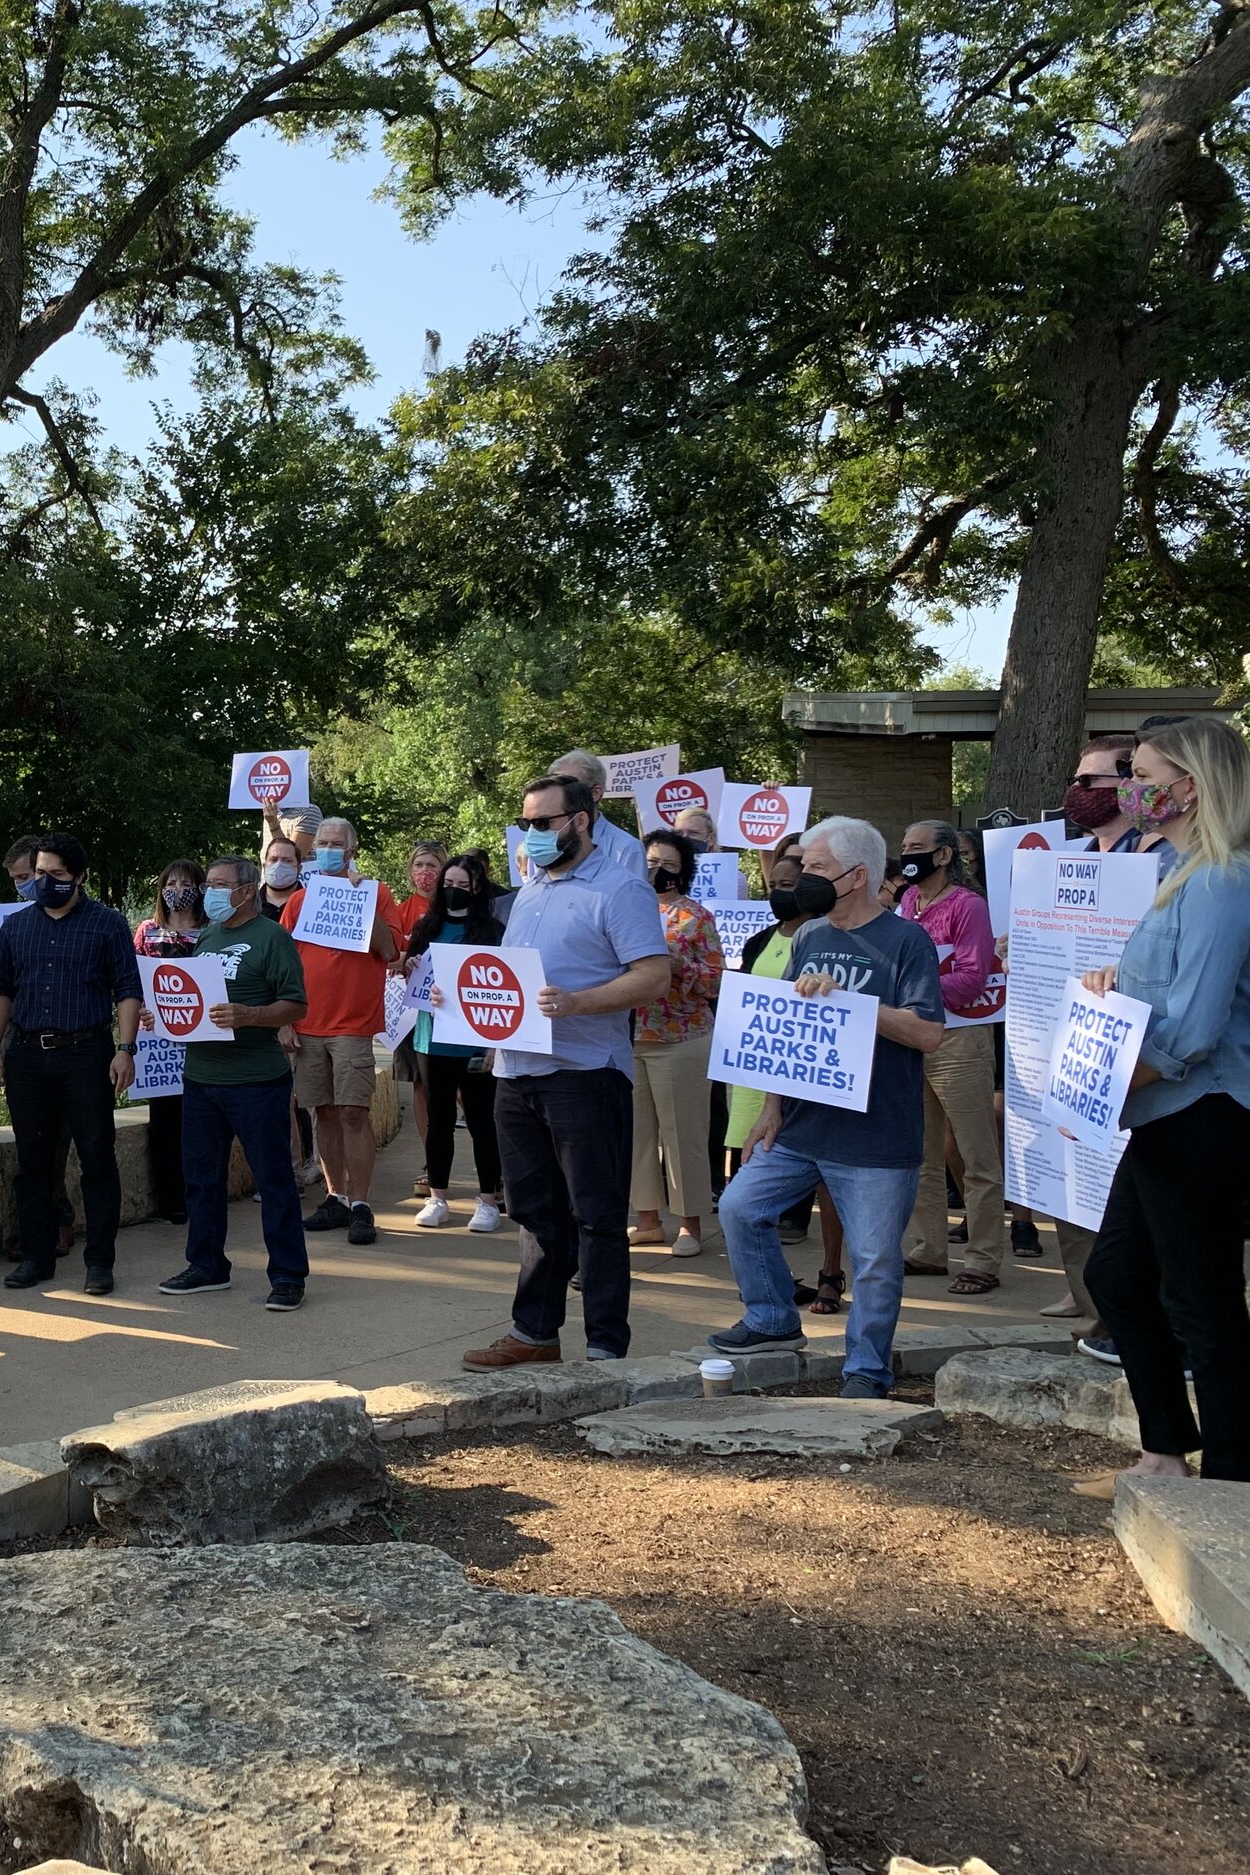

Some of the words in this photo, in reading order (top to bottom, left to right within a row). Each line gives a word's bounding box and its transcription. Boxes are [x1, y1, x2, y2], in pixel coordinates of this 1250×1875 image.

[259, 762, 282, 775] NO
[610, 753, 667, 770] PROTECT
[615, 763, 661, 777] AUSTIN
[656, 770, 664, 779] &
[254, 785, 285, 798] WAY
[665, 785, 693, 801] NO
[753, 797, 780, 812] NO
[745, 823, 781, 838] WAY
[1059, 863, 1073, 878] NO
[1075, 863, 1098, 880] WAY
[319, 886, 369, 902] PROTECT
[1057, 888, 1086, 905] PROP
[1087, 890, 1096, 906] A
[321, 899, 363, 914] AUSTIN
[315, 911, 354, 928] PARKS
[356, 916, 362, 928] &
[714, 909, 775, 922] PROTEC
[1014, 908, 1031, 917] Austin
[1031, 908, 1051, 920] Groups
[1051, 910, 1088, 923] Representing
[1089, 914, 1112, 924] Diverse
[303, 922, 366, 941] LIBRARIES!
[1036, 920, 1066, 932] Opposition
[1066, 923, 1074, 932] To
[1075, 924, 1087, 934] This
[1088, 925, 1111, 936] Terrible
[820, 952, 836, 960] IT'S
[838, 953, 853, 961] MY
[158, 975, 183, 992] NO
[469, 964, 504, 987] NO
[991, 976, 999, 984] A
[158, 995, 165, 1003] ON
[467, 990, 480, 1000] ON
[480, 992, 506, 1002] PROP.
[506, 994, 513, 1002] A
[160, 1007, 195, 1025] WAY
[469, 1005, 515, 1028] WAY
[741, 991, 852, 1027] PROTECT
[747, 1014, 837, 1046] AUSTIN
[1068, 1001, 1133, 1045] PROTECT
[147, 1049, 186, 1063] AUST
[740, 1032, 817, 1063] PARKS
[824, 1048, 840, 1067] &
[1066, 1030, 1118, 1070] AUSTIN
[144, 1061, 184, 1076] PARK
[722, 1048, 855, 1092] LIBRARIES!
[1060, 1053, 1100, 1092] PARKS
[1099, 1074, 1111, 1098] &
[136, 1074, 181, 1088] LIBRA
[1050, 1075, 1114, 1129] LIBRARIES!
